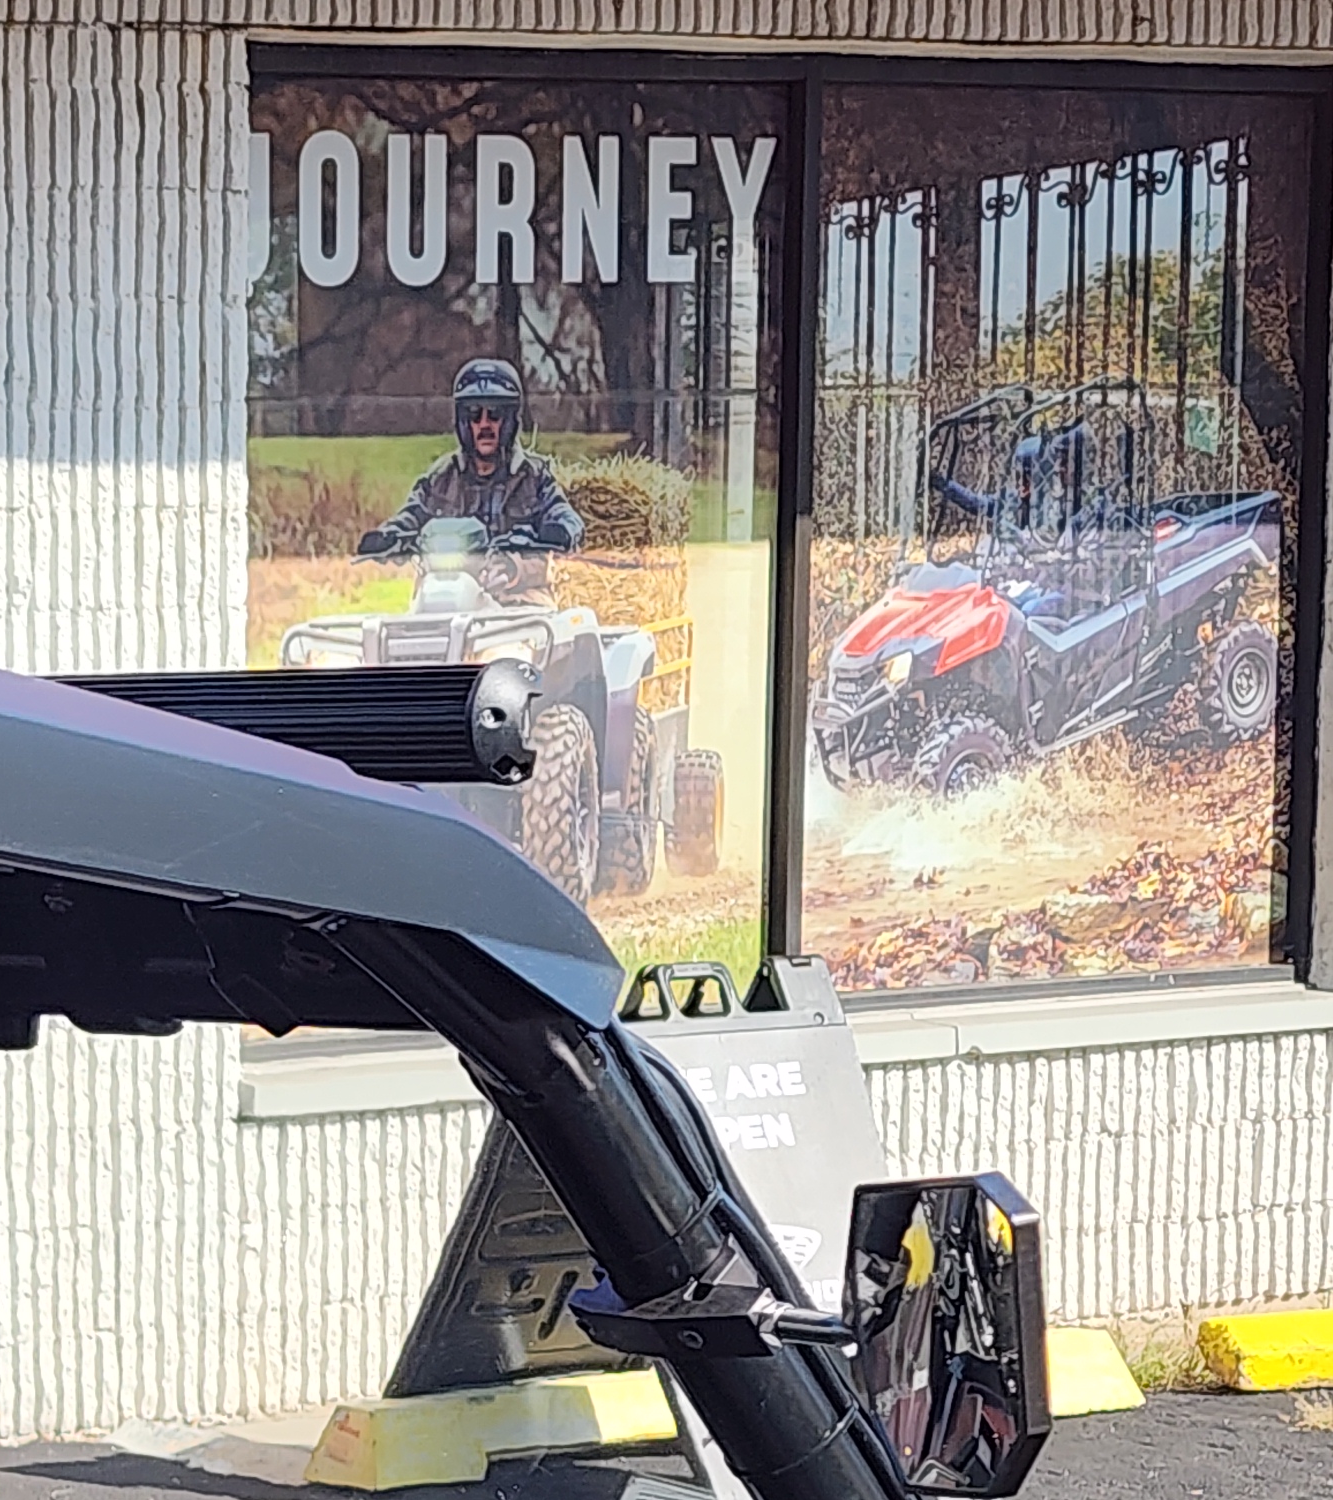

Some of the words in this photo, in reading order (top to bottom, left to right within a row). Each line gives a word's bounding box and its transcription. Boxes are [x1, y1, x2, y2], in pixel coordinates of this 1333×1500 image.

[682, 1065, 718, 1103] E
[726, 1060, 807, 1100] ARE
[713, 1112, 796, 1150] PEN
